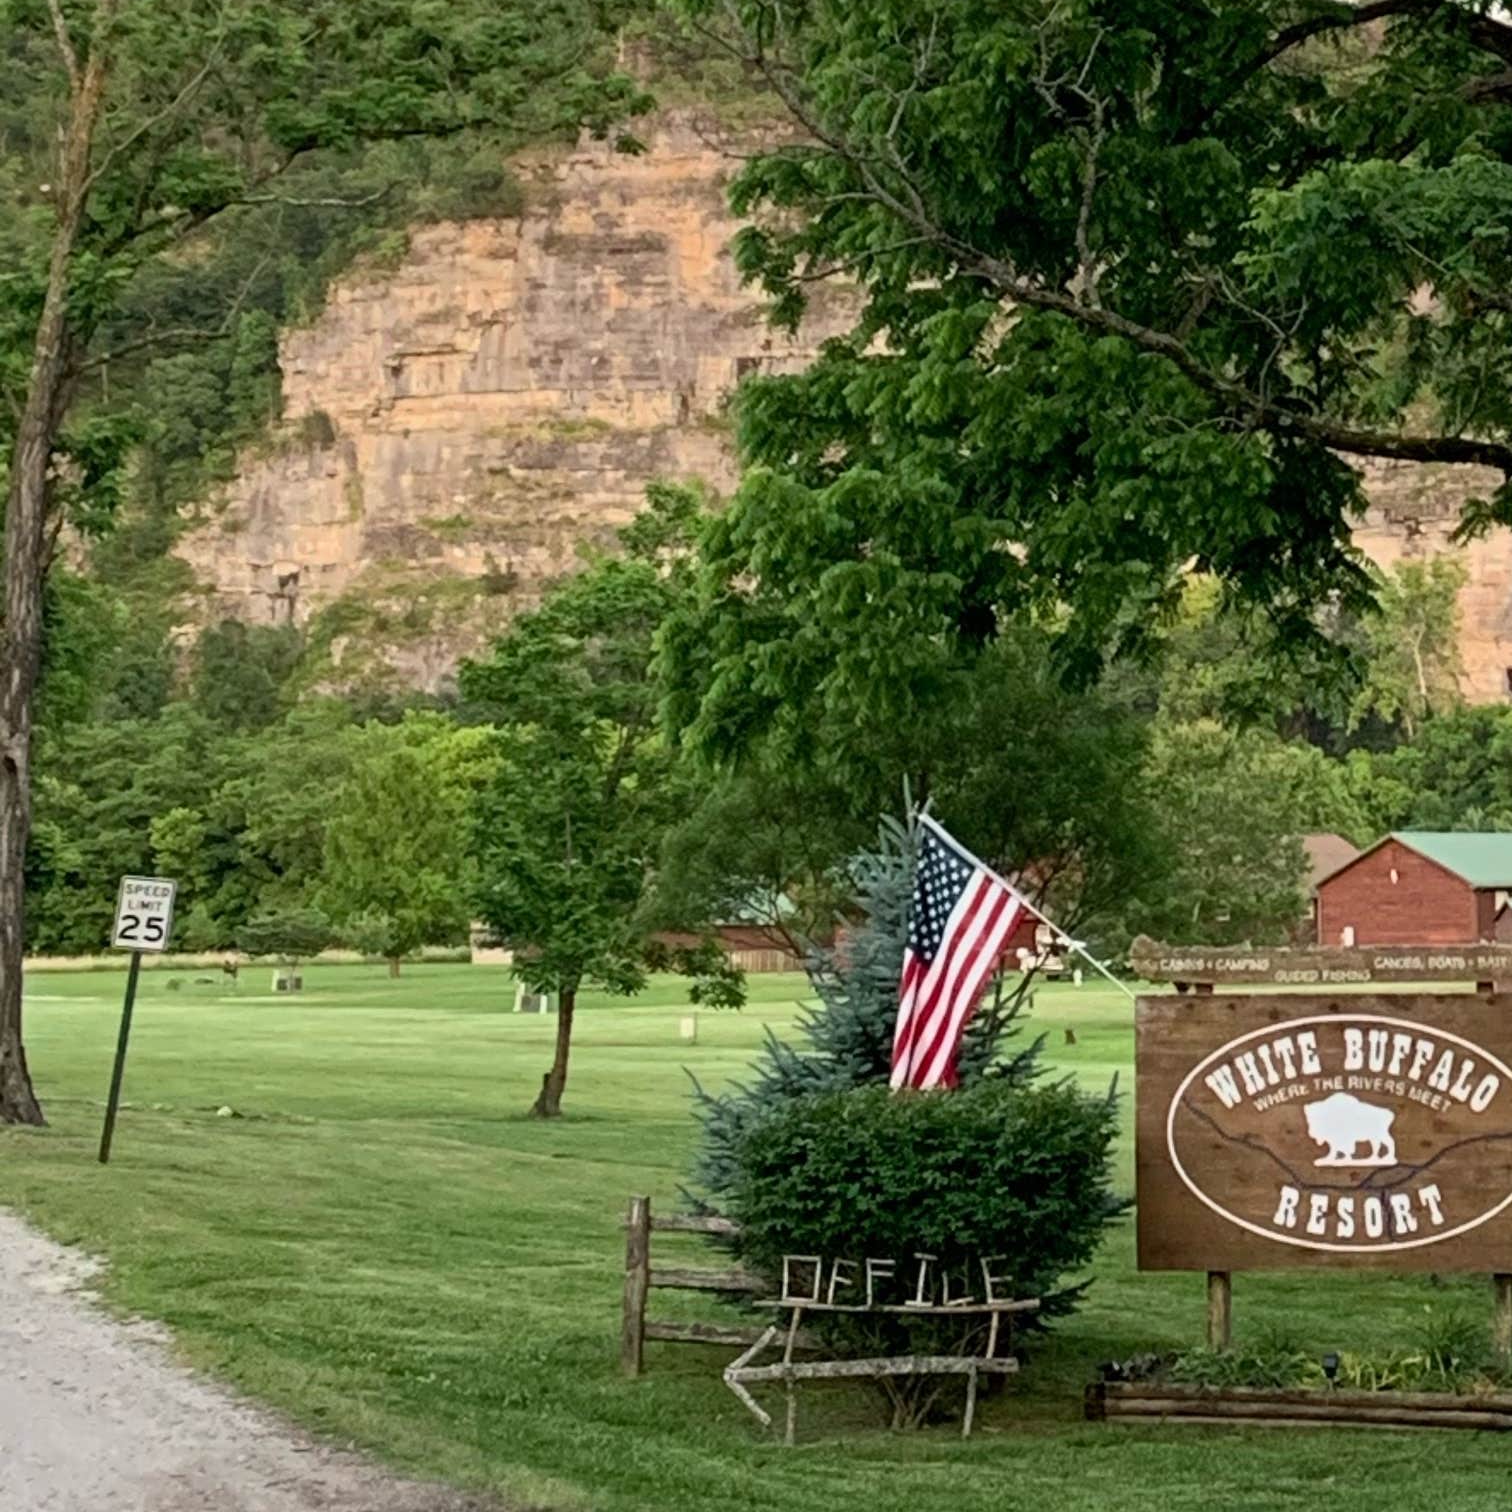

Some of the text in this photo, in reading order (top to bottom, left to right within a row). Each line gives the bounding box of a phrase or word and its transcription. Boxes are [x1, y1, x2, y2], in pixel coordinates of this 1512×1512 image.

[126, 884, 170, 897] SPEED
[128, 899, 163, 911] LIMIT
[118, 914, 164, 942] 25
[1159, 958, 1270, 972] CABINS CAMPING
[1428, 956, 1466, 970] BOATS
[1477, 956, 1508, 968] BAIT
[1274, 969, 1371, 983] GUIDED FISHING
[1204, 1028, 1500, 1114] WHITE BUFFALO
[1253, 1075, 1453, 1114] WHERE THE RIVERS MEET
[1273, 1184, 1444, 1238] RESORT
